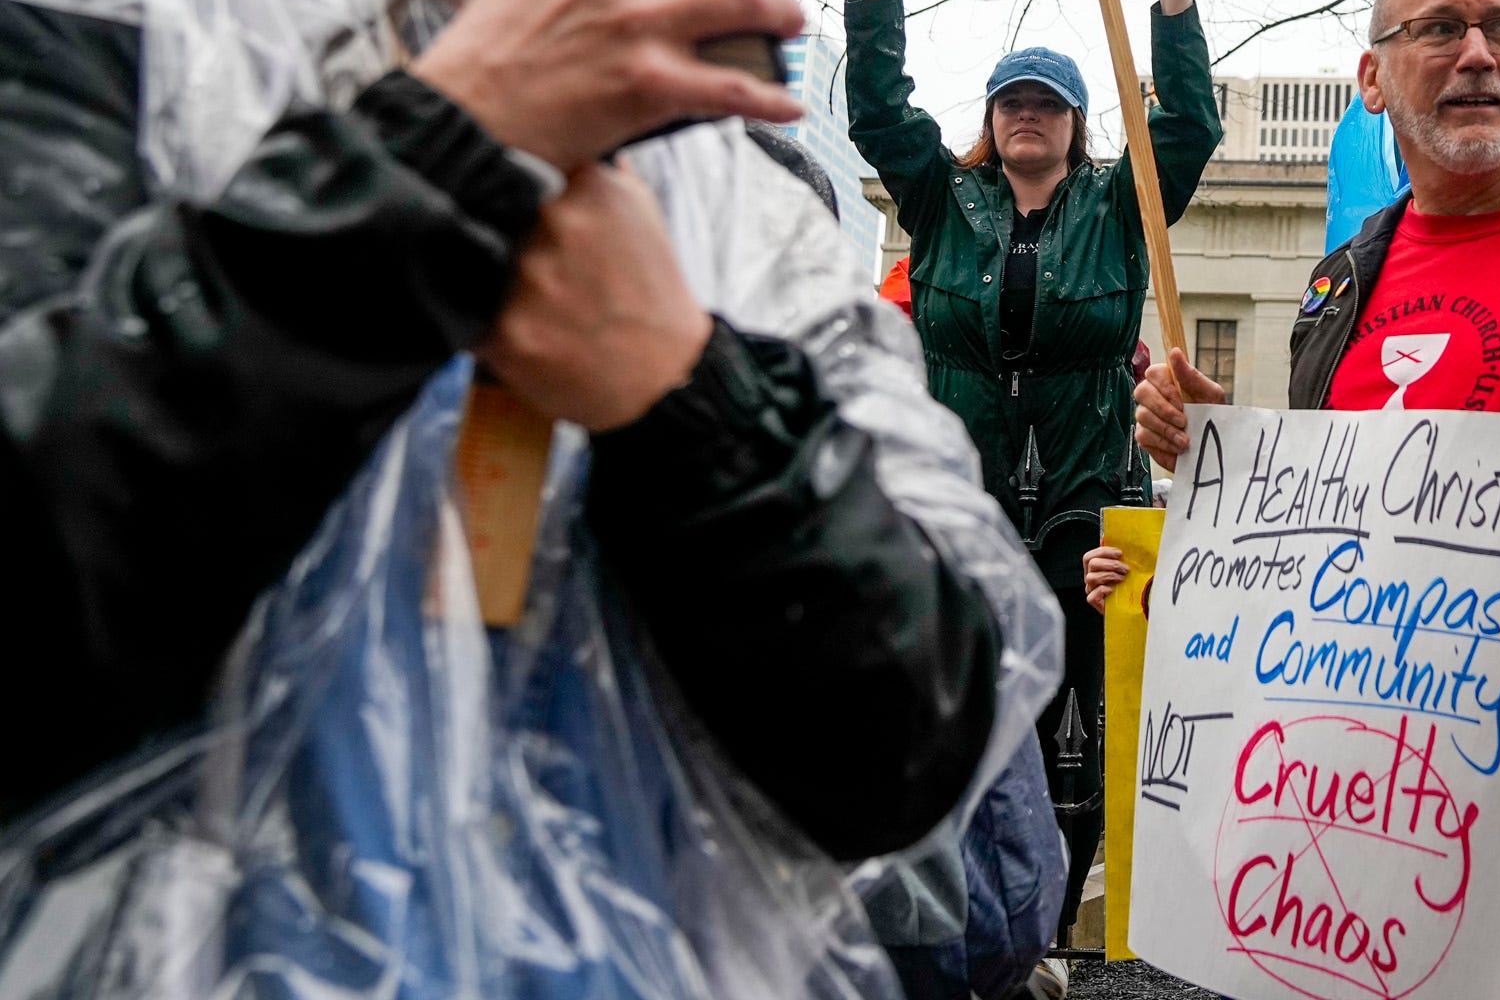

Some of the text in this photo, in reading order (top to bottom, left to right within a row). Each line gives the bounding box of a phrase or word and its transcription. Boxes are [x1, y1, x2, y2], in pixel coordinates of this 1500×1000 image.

[1186, 419, 1225, 527] A
[1172, 538, 1305, 605] promotes
[1185, 615, 1239, 664] and
[1142, 702, 1234, 779] NOT
[1235, 715, 1478, 912] Cruelty
[1227, 854, 1406, 974] Chaos
